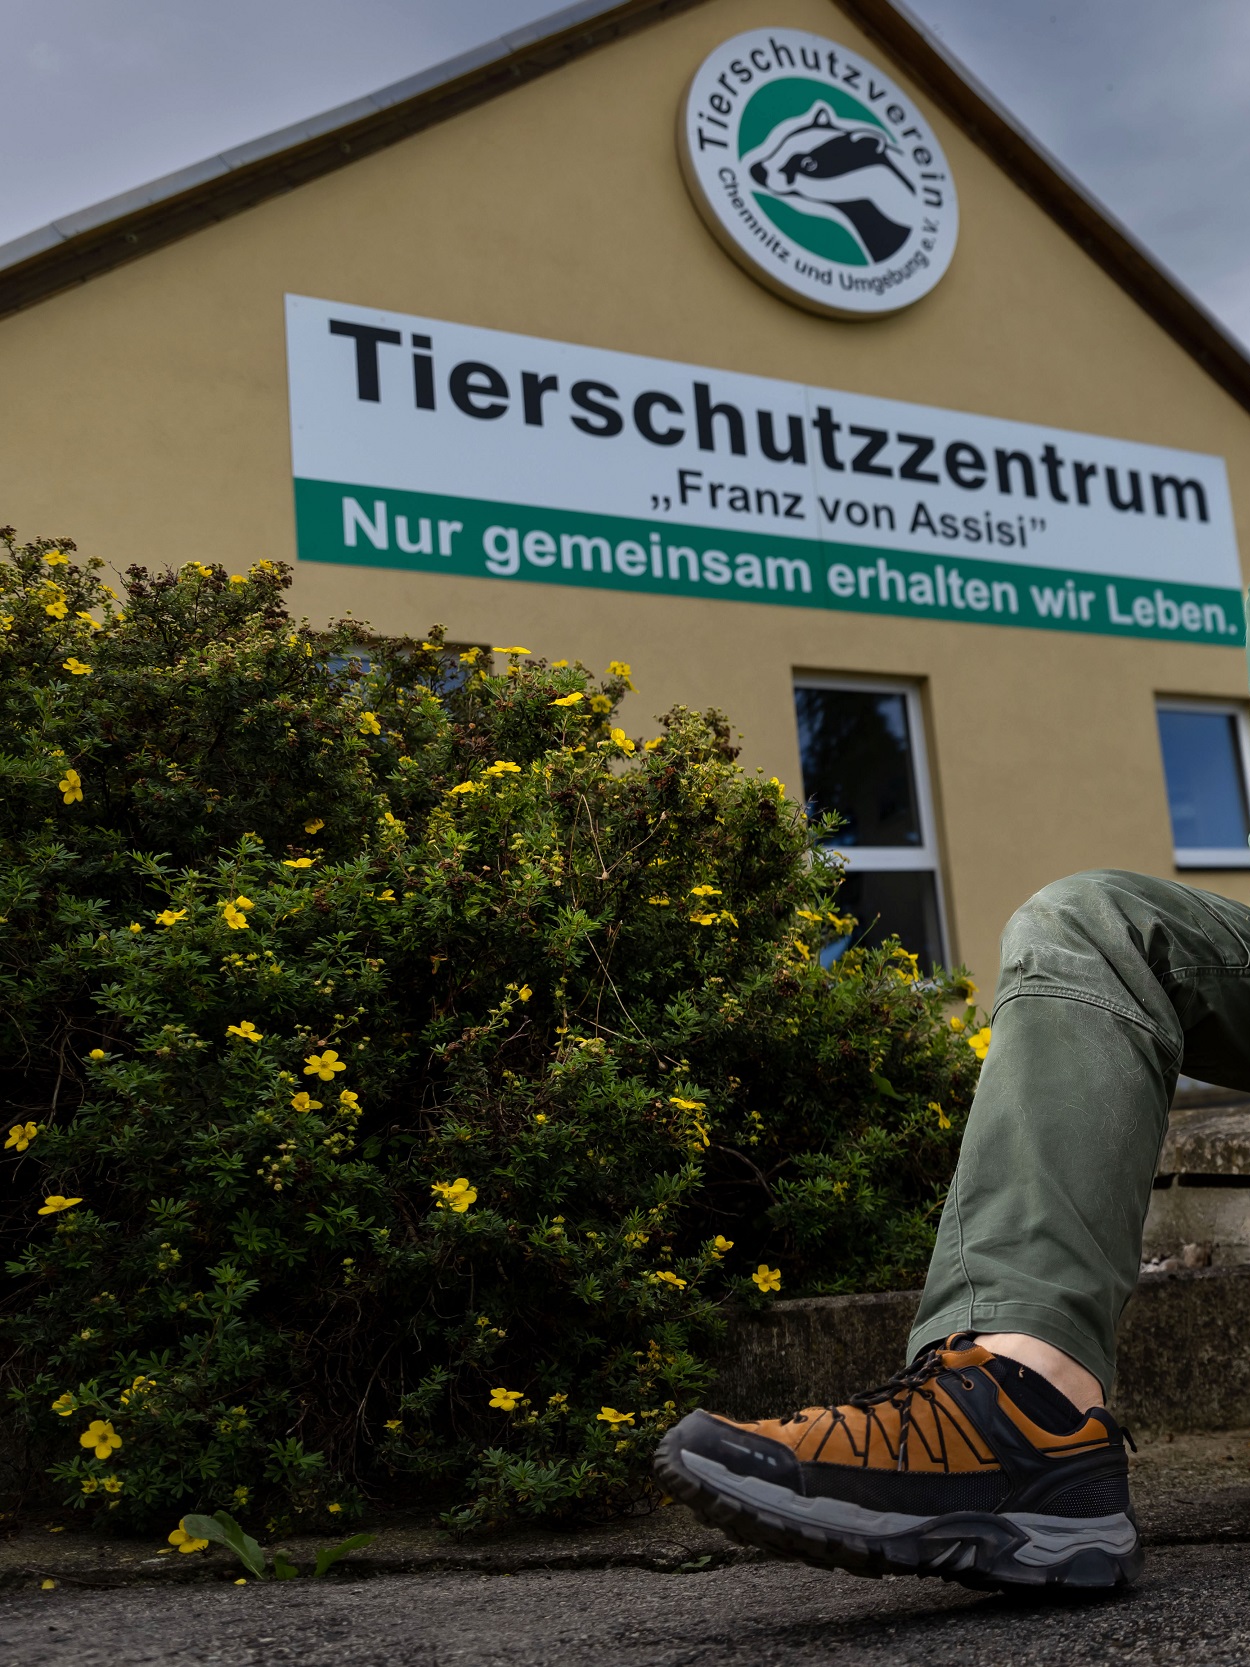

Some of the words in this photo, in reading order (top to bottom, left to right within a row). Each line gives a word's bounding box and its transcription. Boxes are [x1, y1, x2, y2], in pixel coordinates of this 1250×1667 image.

[697, 37, 945, 210] Tierschutzverein
[718, 167, 789, 263] Chemnitz
[795, 260, 833, 286] und
[839, 249, 930, 295] Umgebung
[328, 318, 1210, 524] Tierschutzzentrum
[342, 496, 464, 557] Nur
[482, 524, 811, 594] gemeinsam
[827, 558, 1019, 615] erhalten
[1030, 580, 1096, 622] wir
[1106, 585, 1239, 636] Leben.
[819, 495, 896, 532] von
